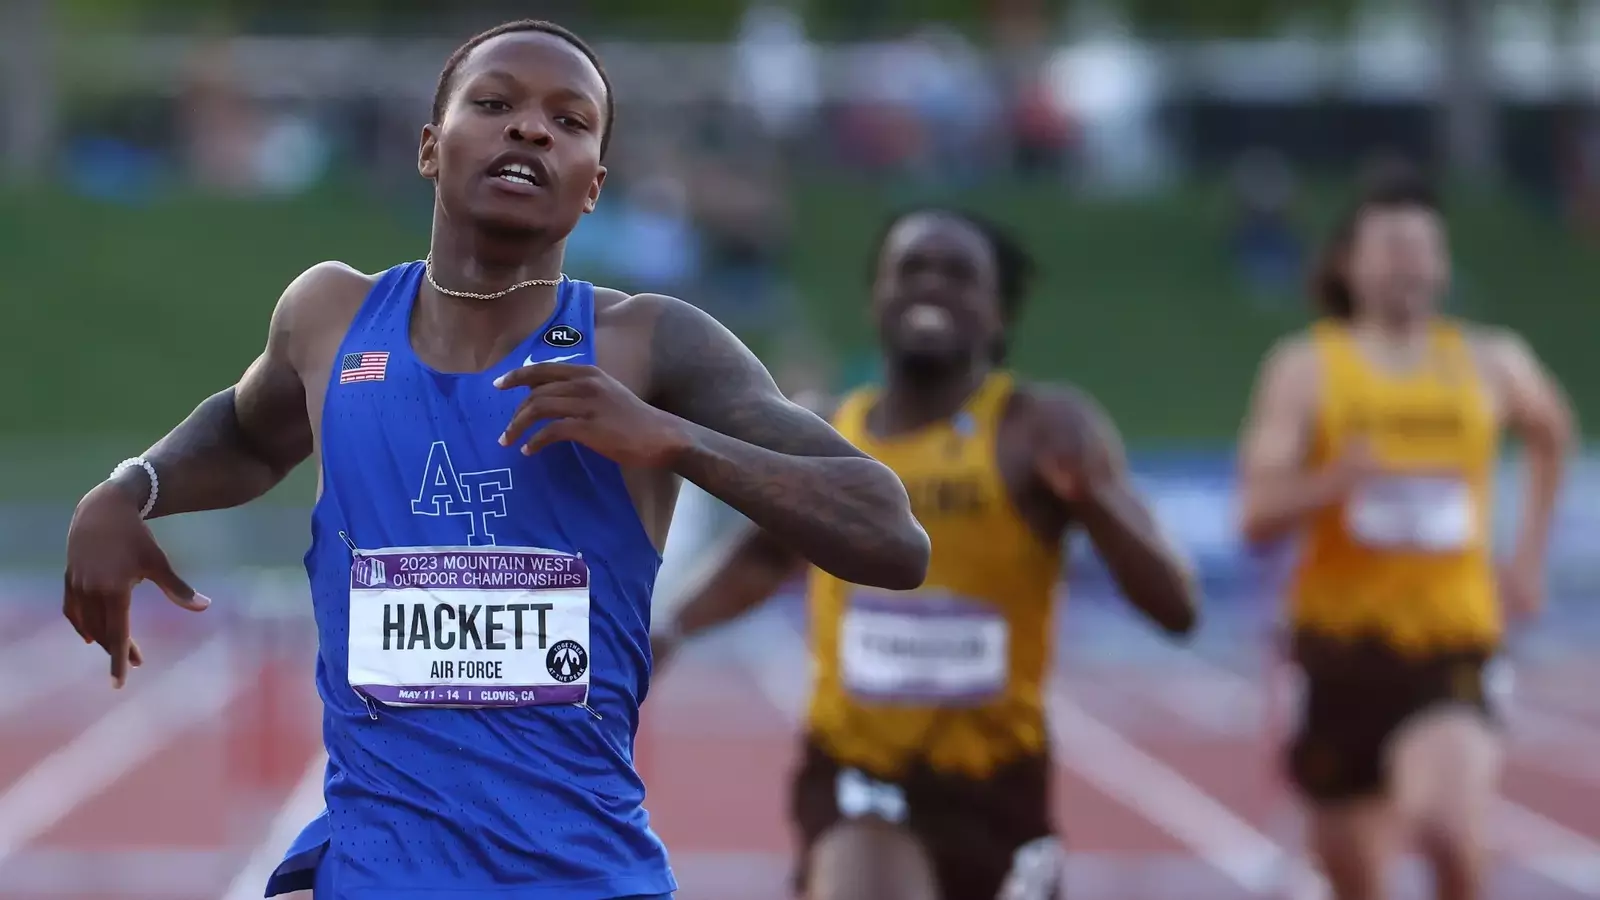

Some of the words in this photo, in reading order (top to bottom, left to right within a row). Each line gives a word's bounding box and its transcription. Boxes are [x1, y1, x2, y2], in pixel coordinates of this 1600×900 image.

[551, 330, 574, 341] RL
[411, 441, 513, 547] AF
[399, 556, 438, 571] 2023
[443, 556, 525, 571] MOUNTAIN
[530, 557, 573, 572] WEST
[393, 572, 458, 586] OUTDOOR
[462, 572, 582, 586] CHAMPIONSHIPS
[382, 603, 554, 651] HACKETT
[553, 642, 584, 656] TOGETHER
[430, 661, 454, 679] AIR
[457, 660, 503, 679] FORCE
[398, 689, 421, 700] MAY
[423, 689, 436, 700] 11
[446, 689, 460, 700] 14
[480, 690, 519, 703] CLOVIS,
[520, 691, 535, 701] CA
